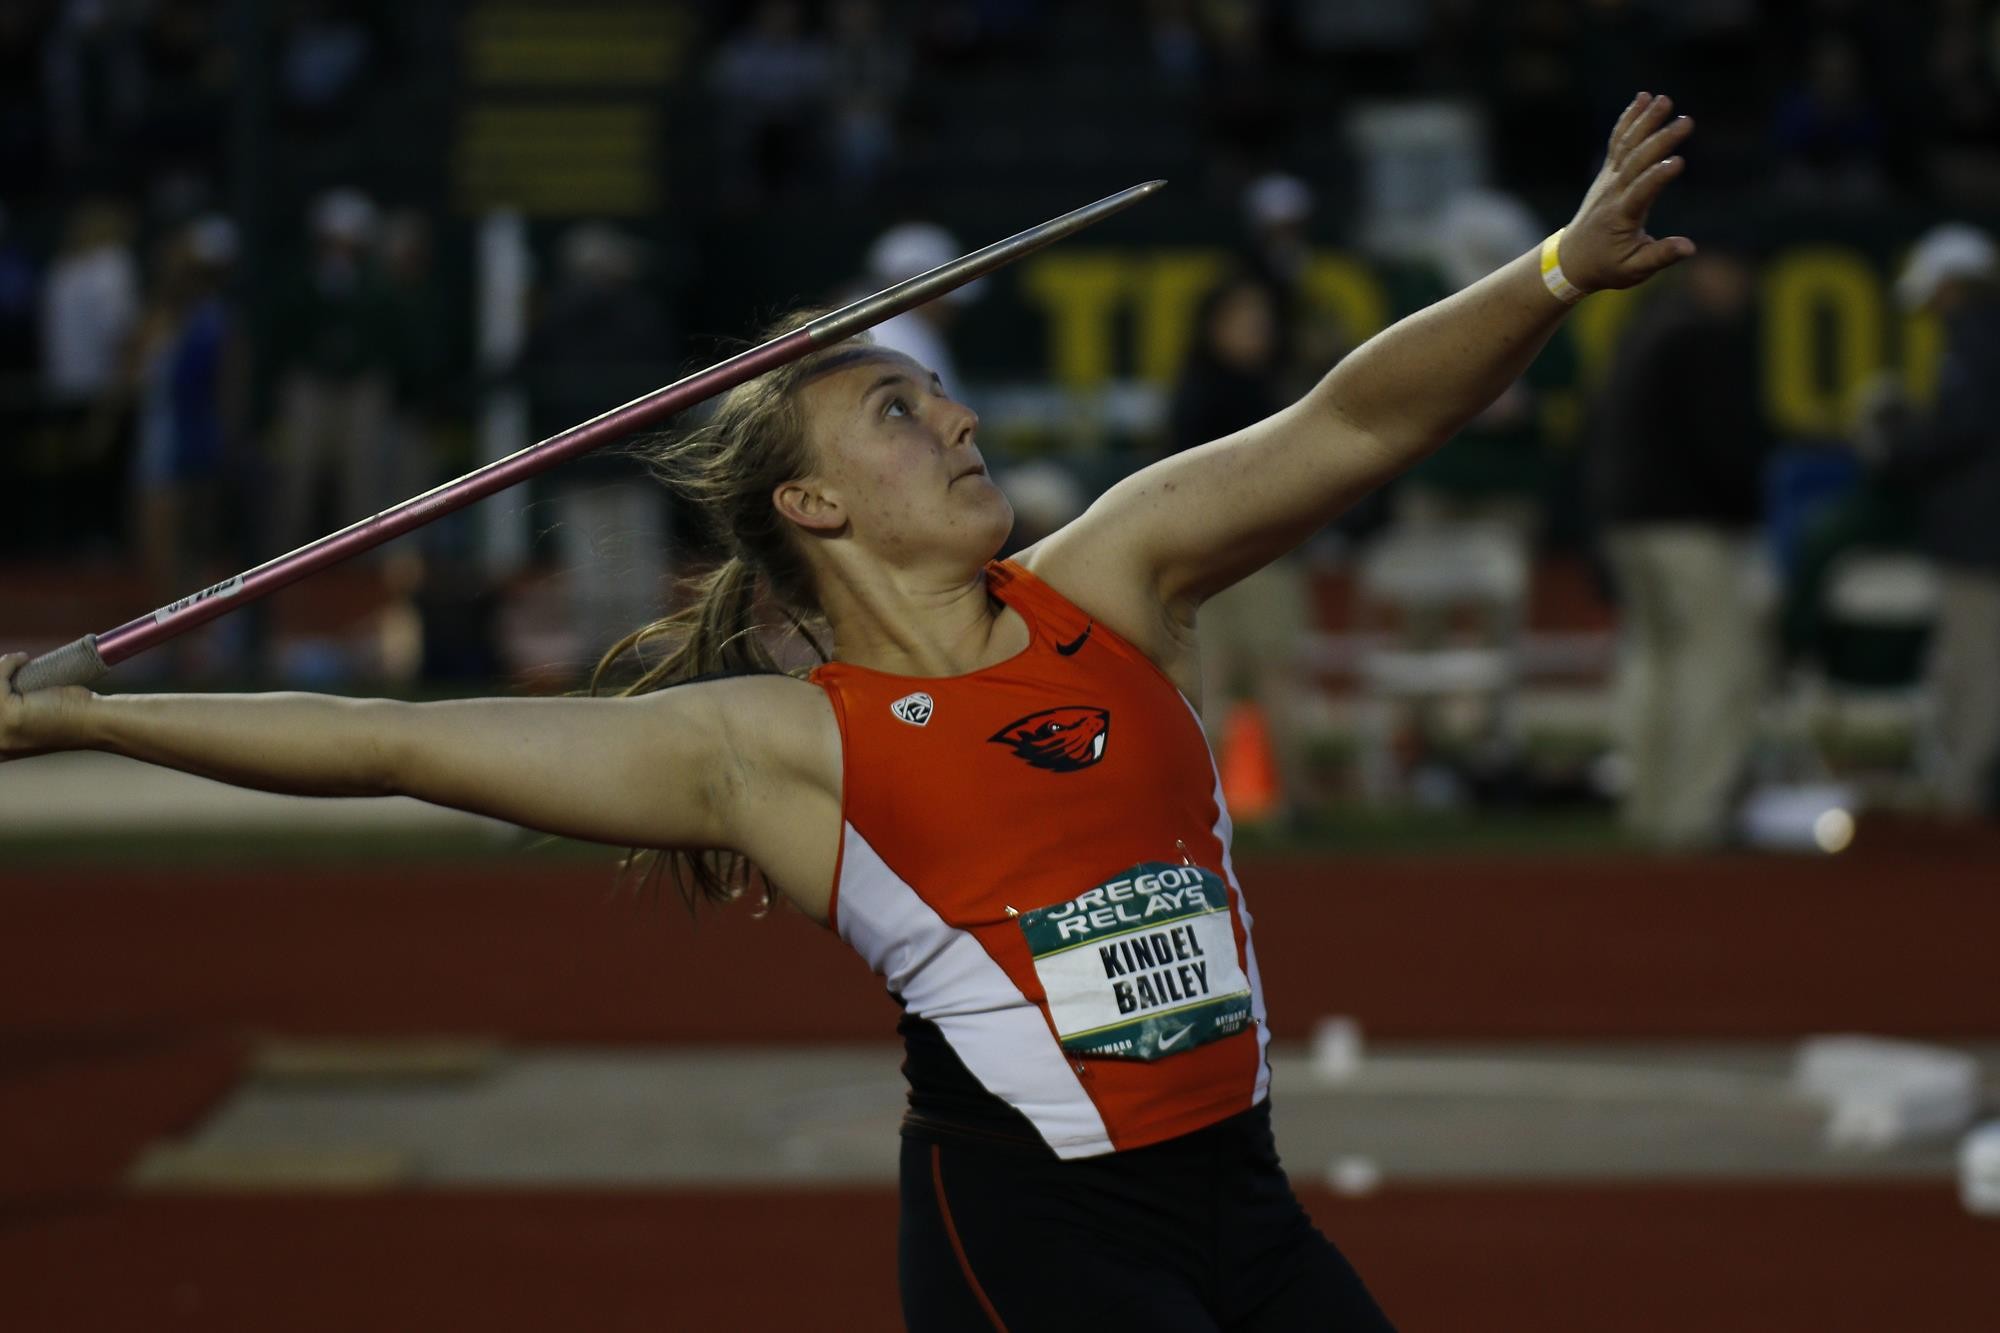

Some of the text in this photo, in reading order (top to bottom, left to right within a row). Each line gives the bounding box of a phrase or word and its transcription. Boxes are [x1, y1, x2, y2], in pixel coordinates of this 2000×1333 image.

[1057, 885, 1206, 940] RELAYS
[1099, 924, 1204, 979] KINDEL
[1113, 961, 1209, 1014] BAILEY
